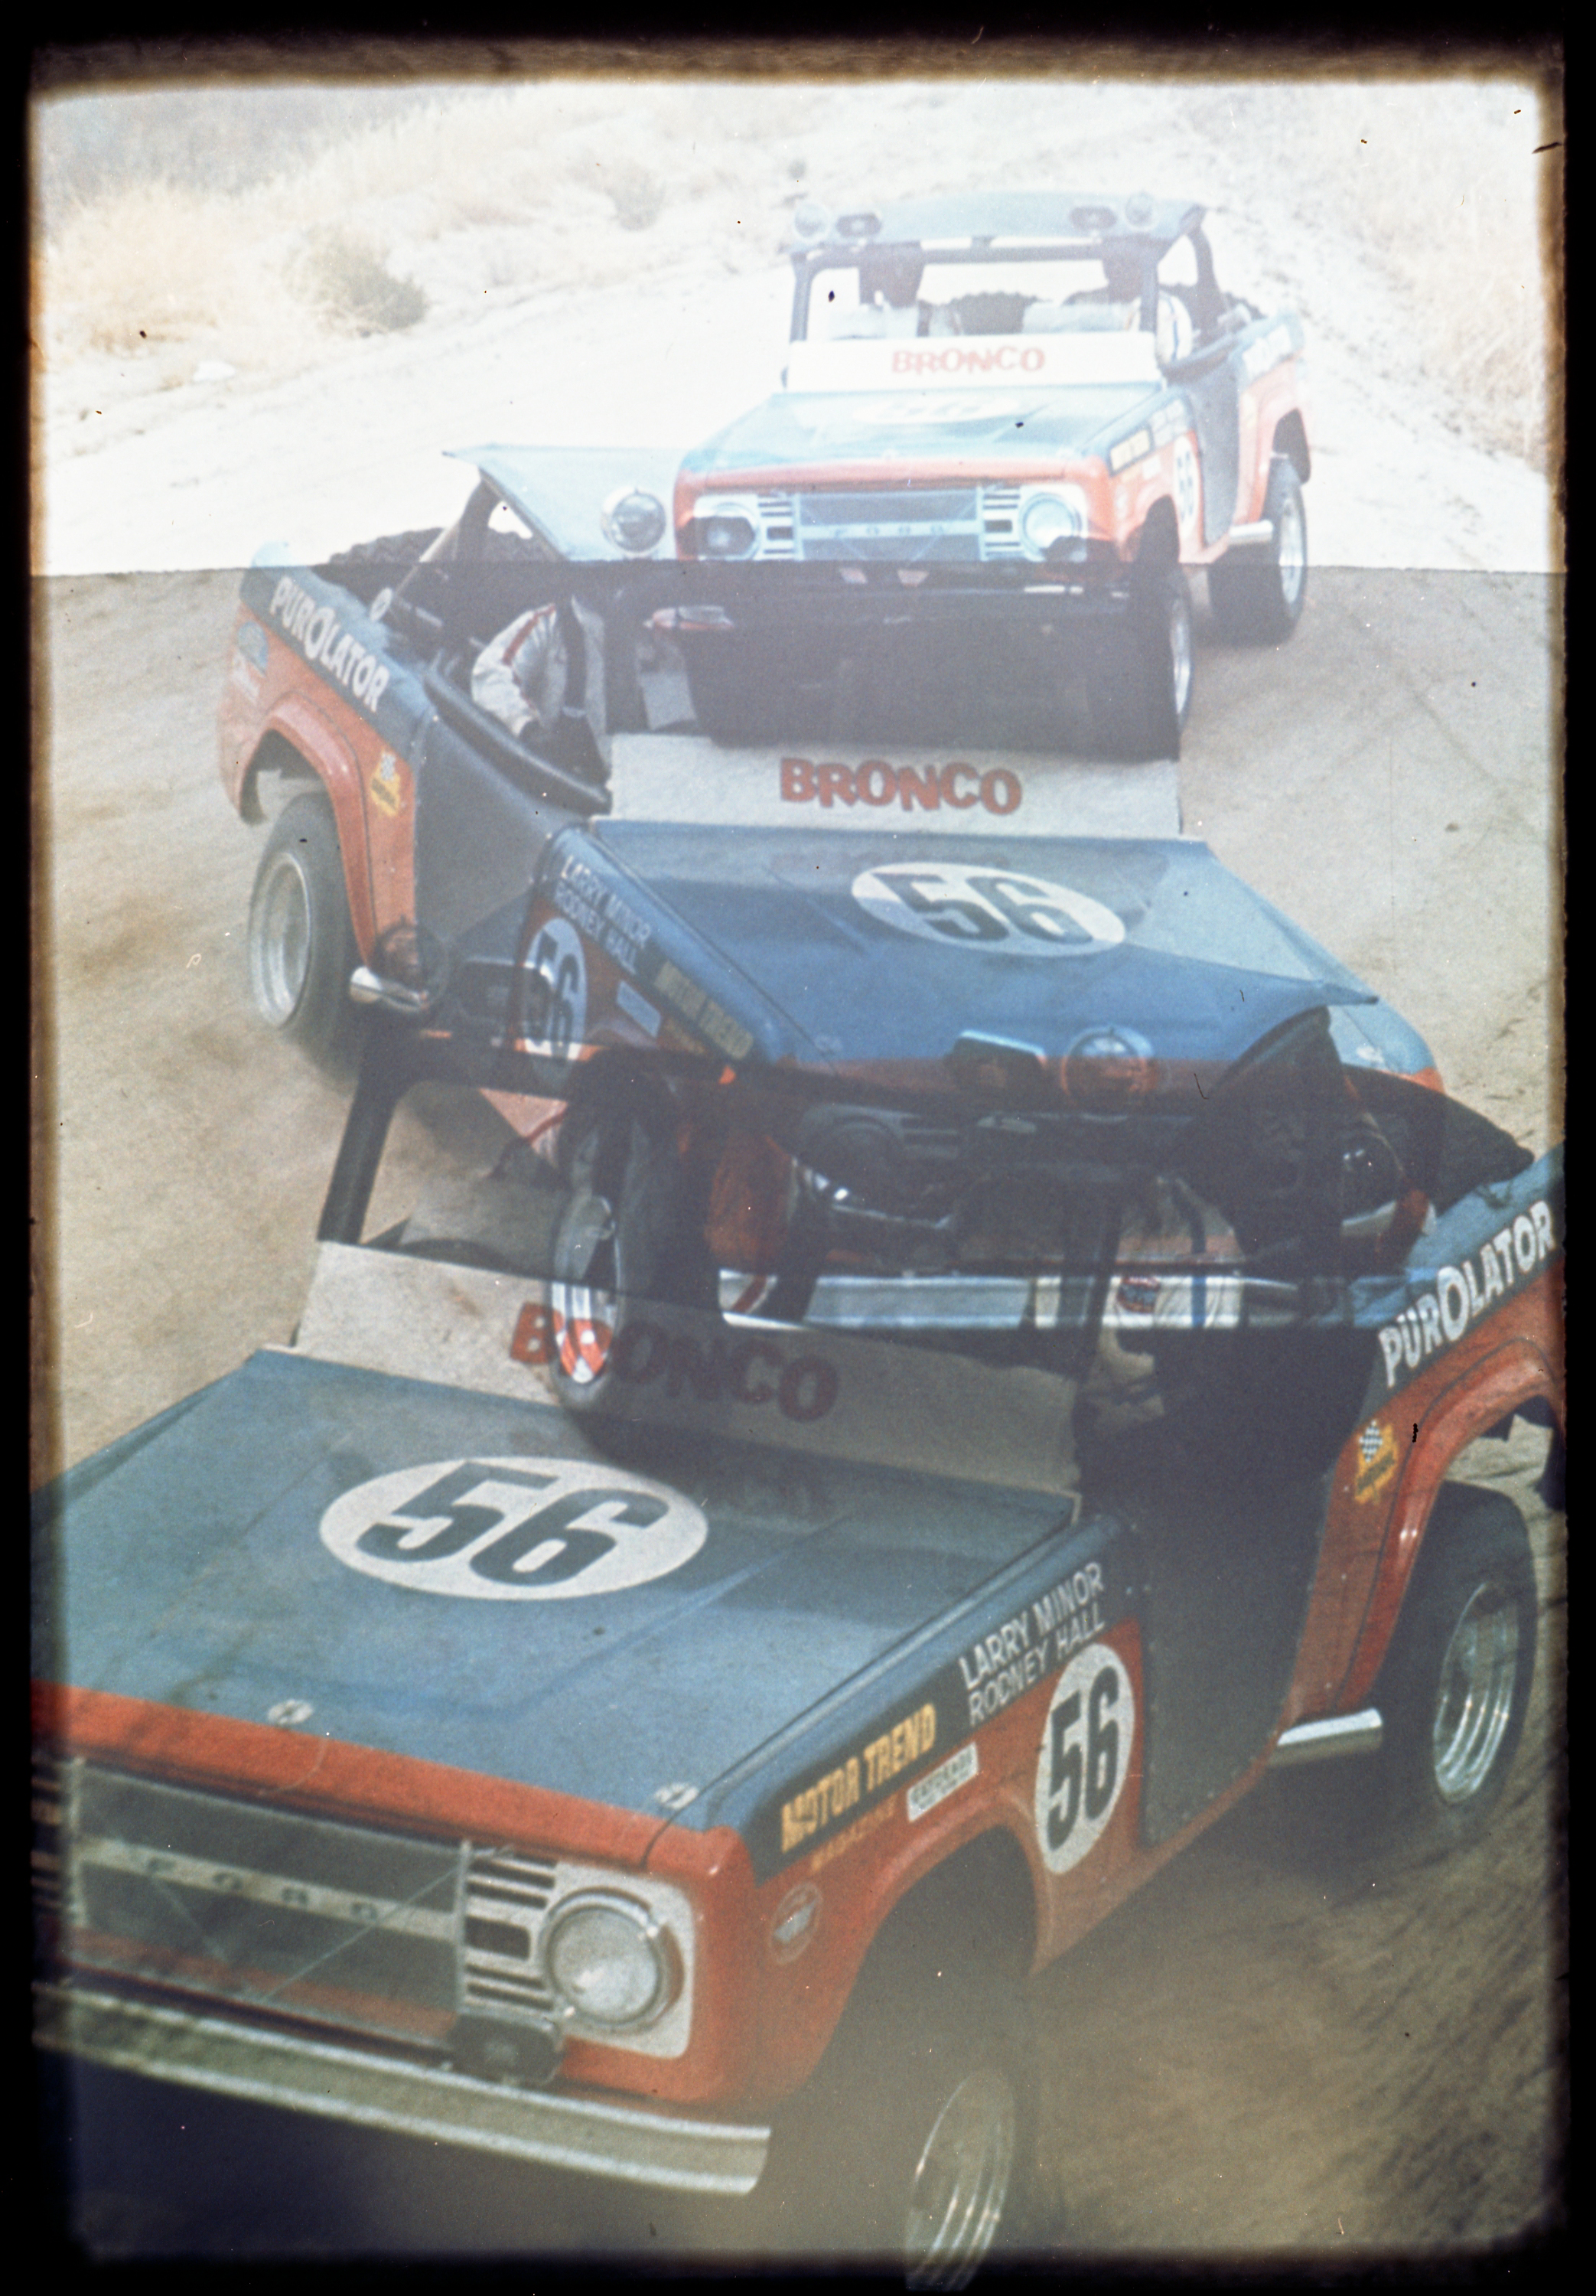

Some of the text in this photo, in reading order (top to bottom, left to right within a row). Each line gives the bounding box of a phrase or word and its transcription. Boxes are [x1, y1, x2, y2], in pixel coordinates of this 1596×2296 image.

[891, 345, 1046, 376] BRONCO
[270, 576, 391, 713] PUROLATOR
[780, 757, 1023, 815] BRONCO
[870, 872, 1094, 946] 56
[1378, 1200, 1555, 1388] PUROLATOR
[509, 1301, 839, 1423] BRONCO
[355, 1461, 671, 1587] 56
[959, 1561, 1106, 1690] LARRY MINOR
[969, 1603, 1106, 1728] RODNEY HALL
[781, 1756, 860, 1855] MOTOR
[864, 1702, 937, 1792] TREND
[1048, 1665, 1120, 1852] 56
